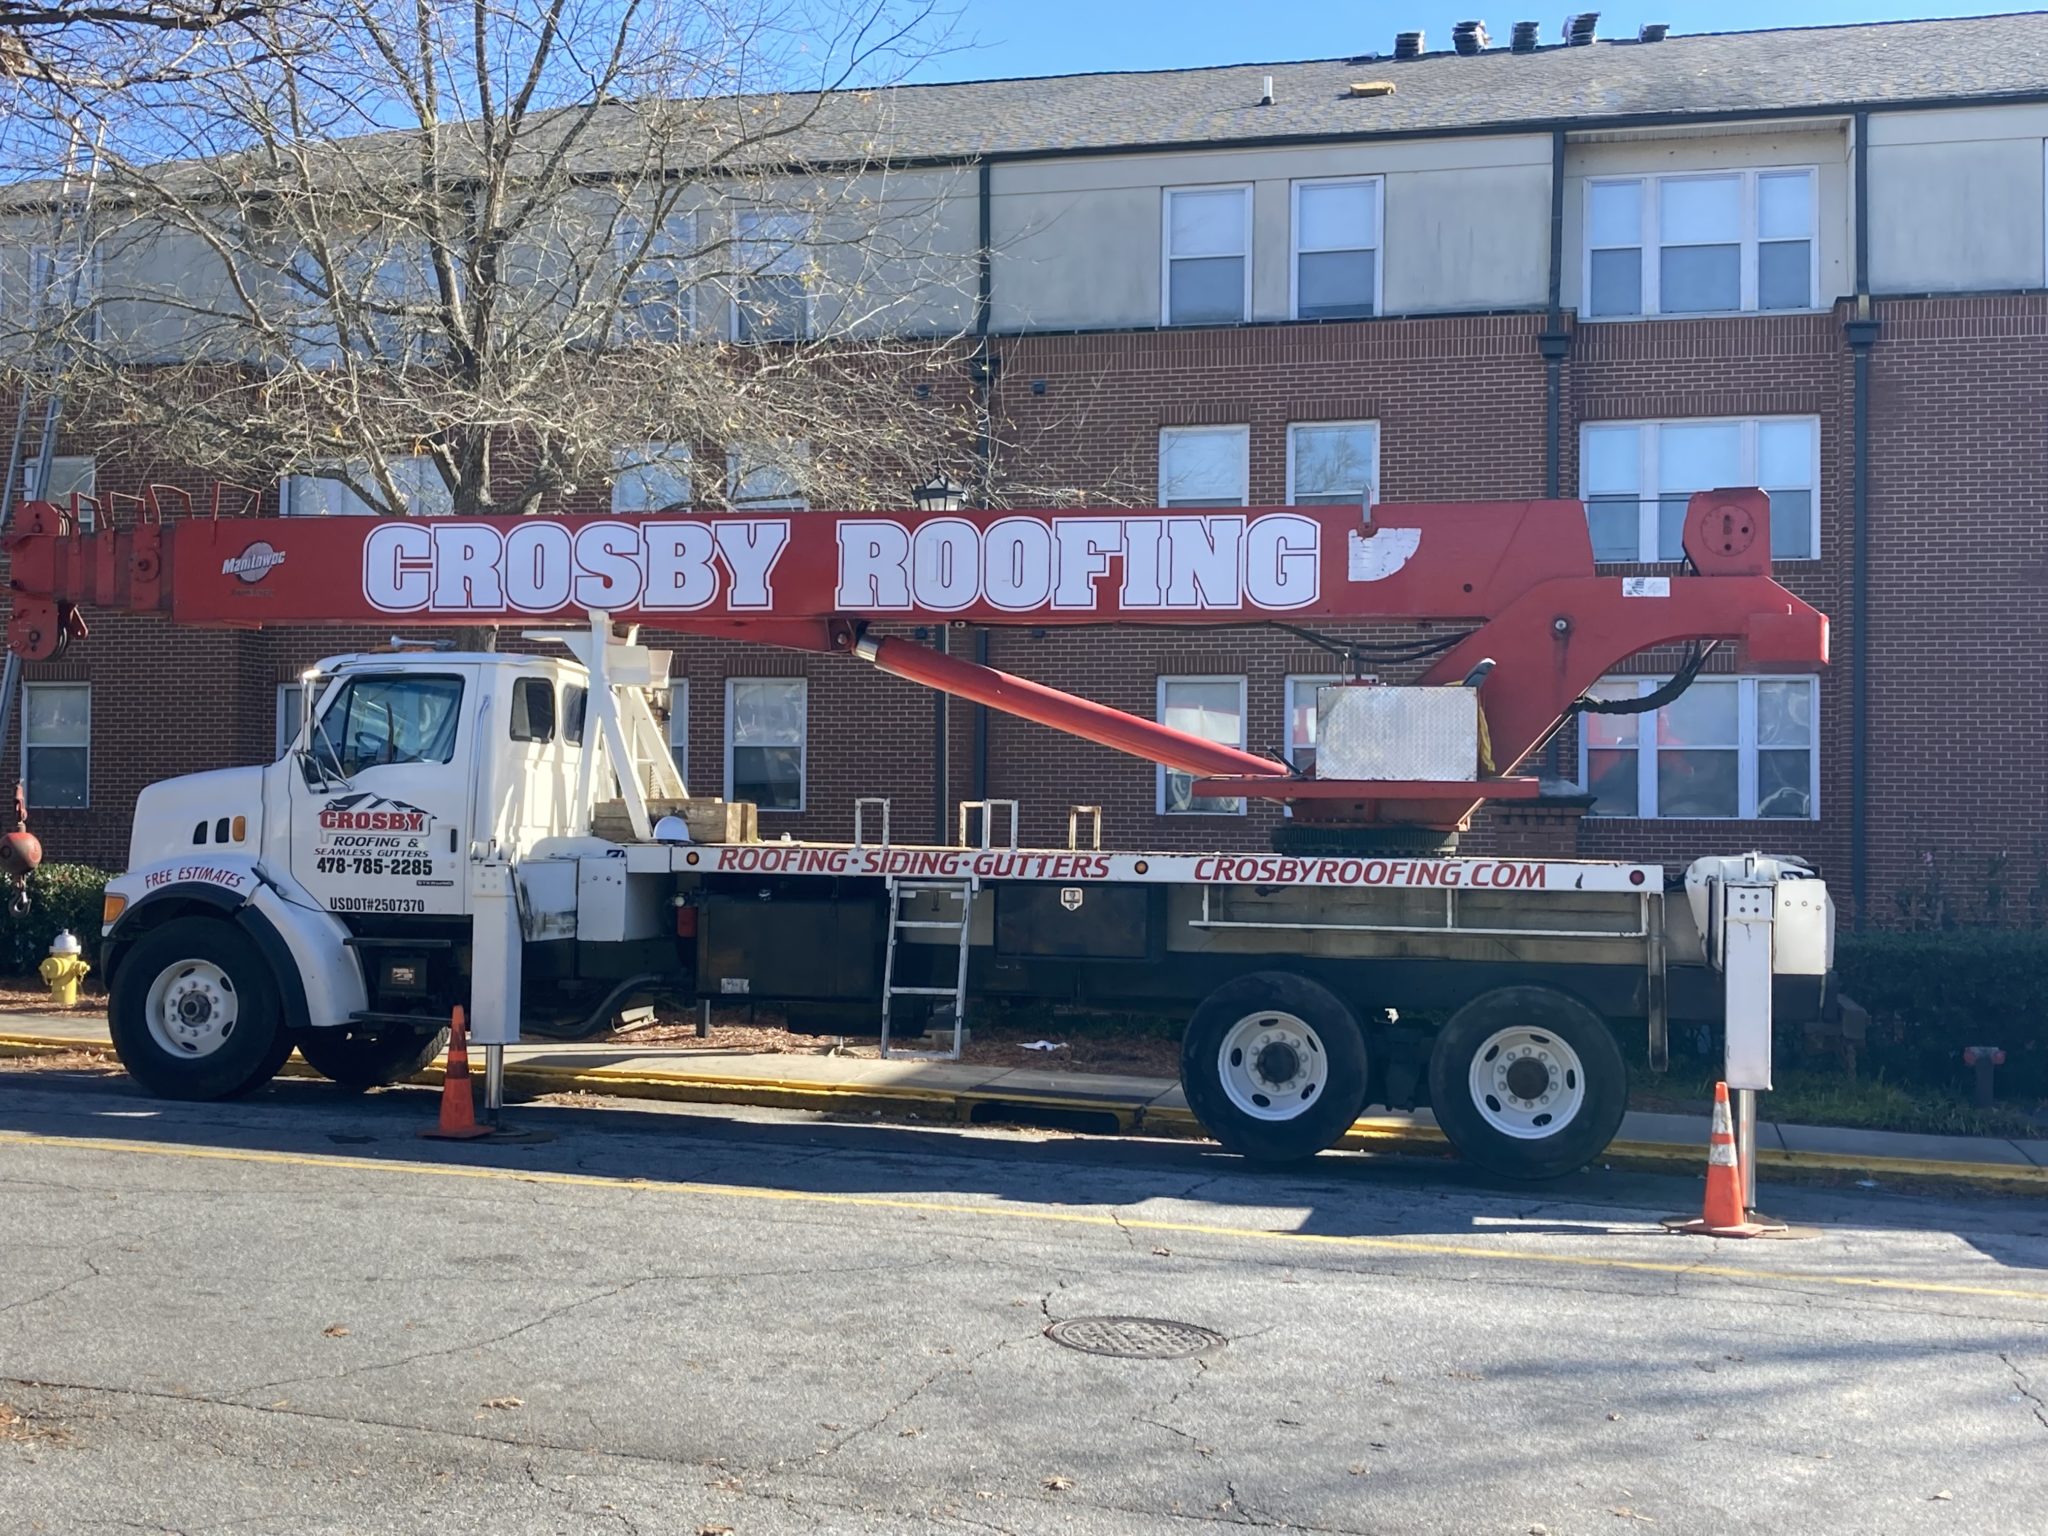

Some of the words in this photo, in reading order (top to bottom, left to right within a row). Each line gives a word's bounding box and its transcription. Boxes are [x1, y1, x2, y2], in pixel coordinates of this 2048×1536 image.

[221, 550, 286, 575] Manitowoc
[362, 518, 791, 614] CROSBY
[834, 512, 1321, 612] ROOFING
[320, 811, 423, 831] CROSBY
[314, 848, 372, 856] SEAMLESS
[333, 837, 400, 847] ROOFING
[408, 838, 419, 847] &
[317, 858, 432, 875] 478-785-2285
[717, 848, 850, 873] ROOFING
[860, 849, 961, 875] SIDING
[973, 853, 1110, 878] GUTTERS
[1194, 858, 1546, 888] CROSBYROOFING.COM
[144, 868, 174, 890] FREE
[177, 865, 246, 889] ESTIMATES
[330, 897, 425, 912] USDOT#2507370
